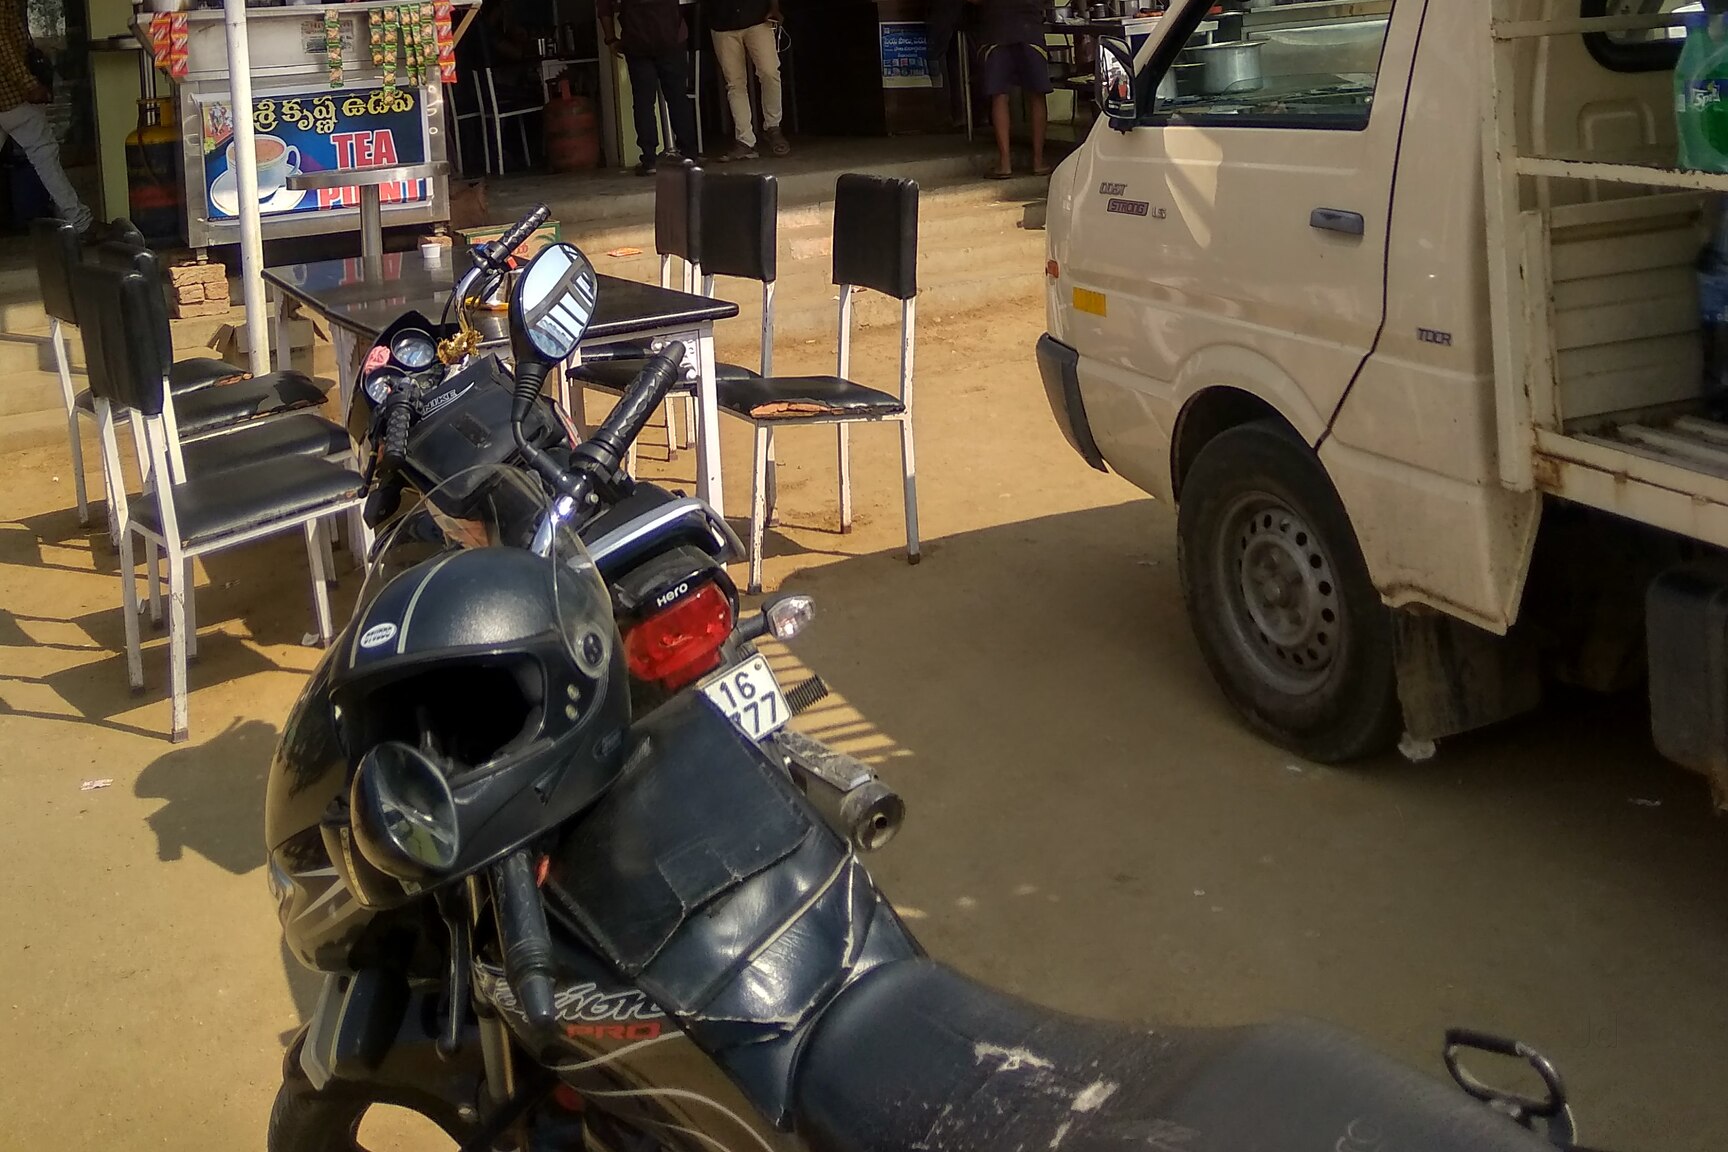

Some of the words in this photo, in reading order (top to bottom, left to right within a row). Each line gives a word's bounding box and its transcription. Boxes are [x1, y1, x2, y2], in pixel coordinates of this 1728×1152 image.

[331, 129, 398, 169] TEA
[719, 672, 756, 708] 16
[566, 1022, 662, 1040] PRO
